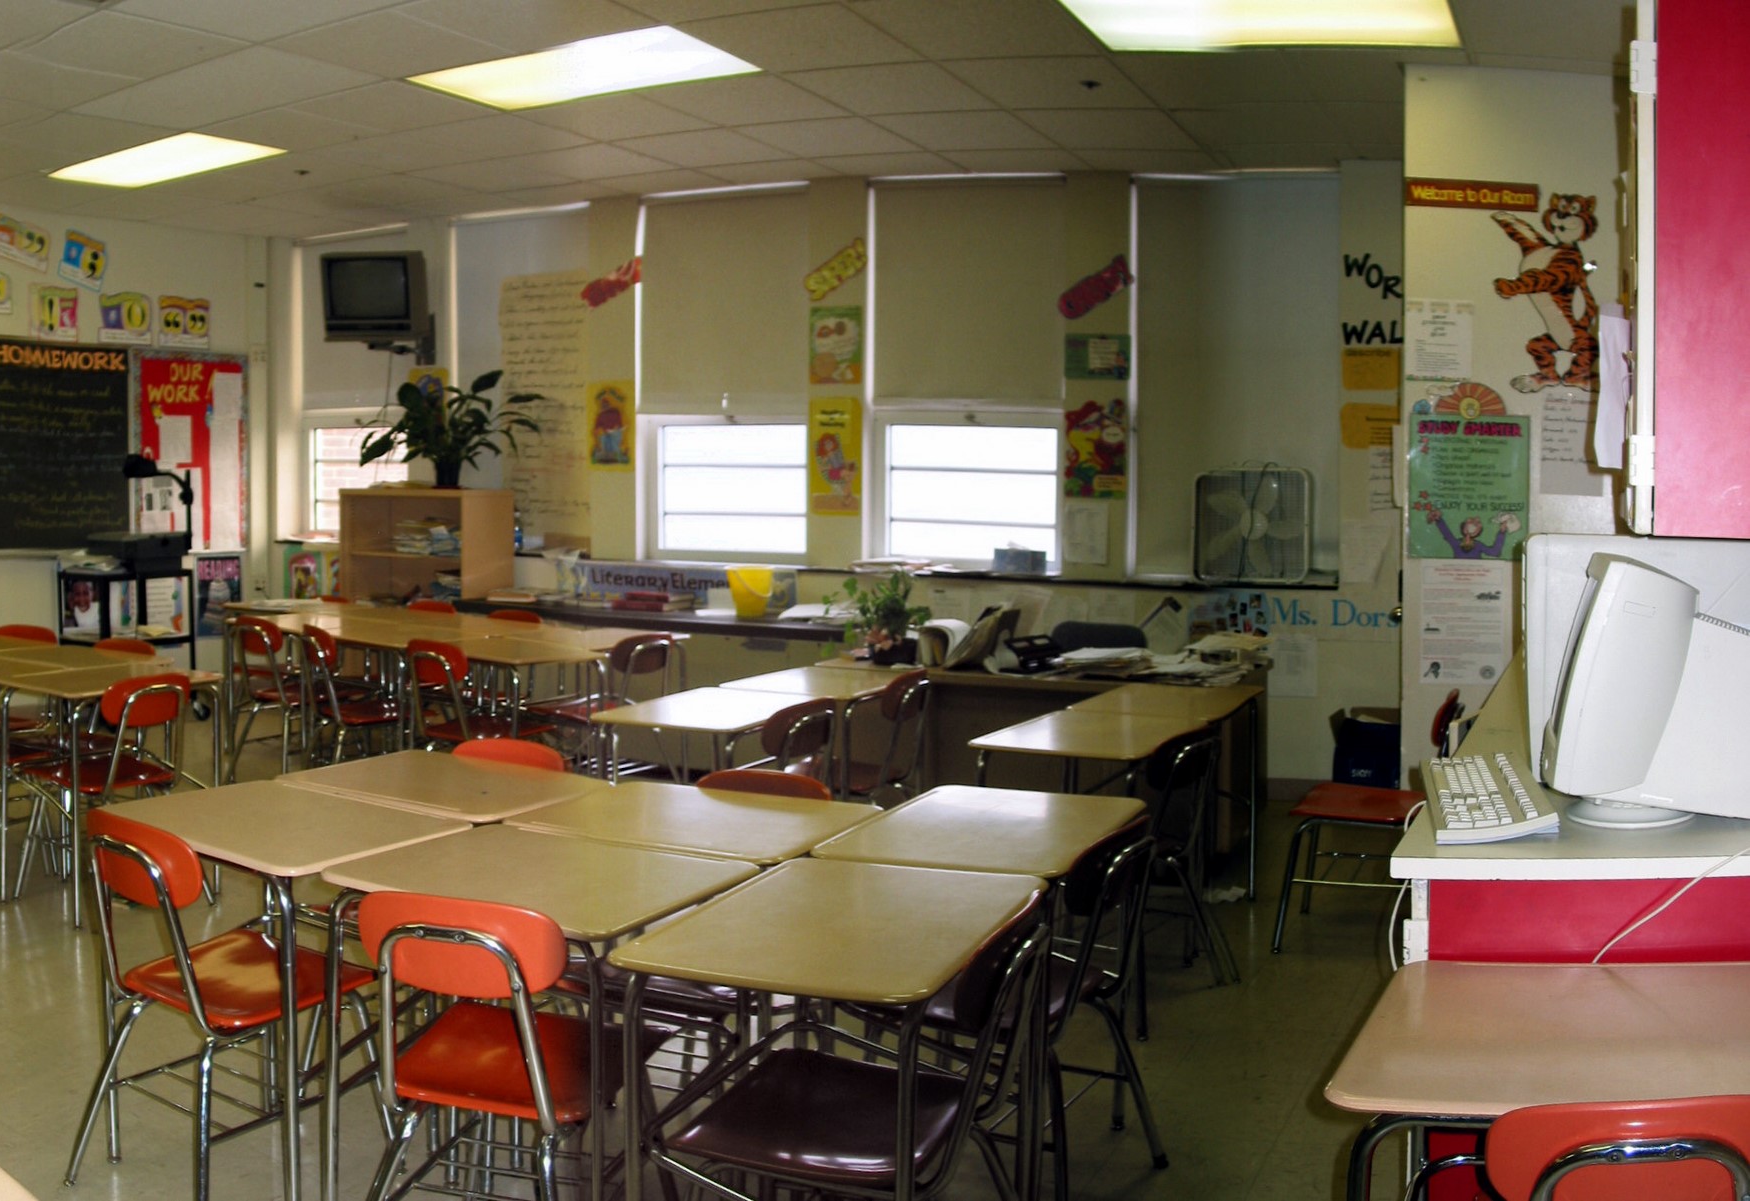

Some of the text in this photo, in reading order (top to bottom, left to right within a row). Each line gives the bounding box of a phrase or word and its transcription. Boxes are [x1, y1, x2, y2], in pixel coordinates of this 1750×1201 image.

[1411, 183, 1536, 207] Welcome to Our Room
[147, 383, 202, 404] WORK
[1417, 420, 1460, 435] STUDY
[591, 567, 670, 591] Literary
[1270, 597, 1319, 627] Ms.
